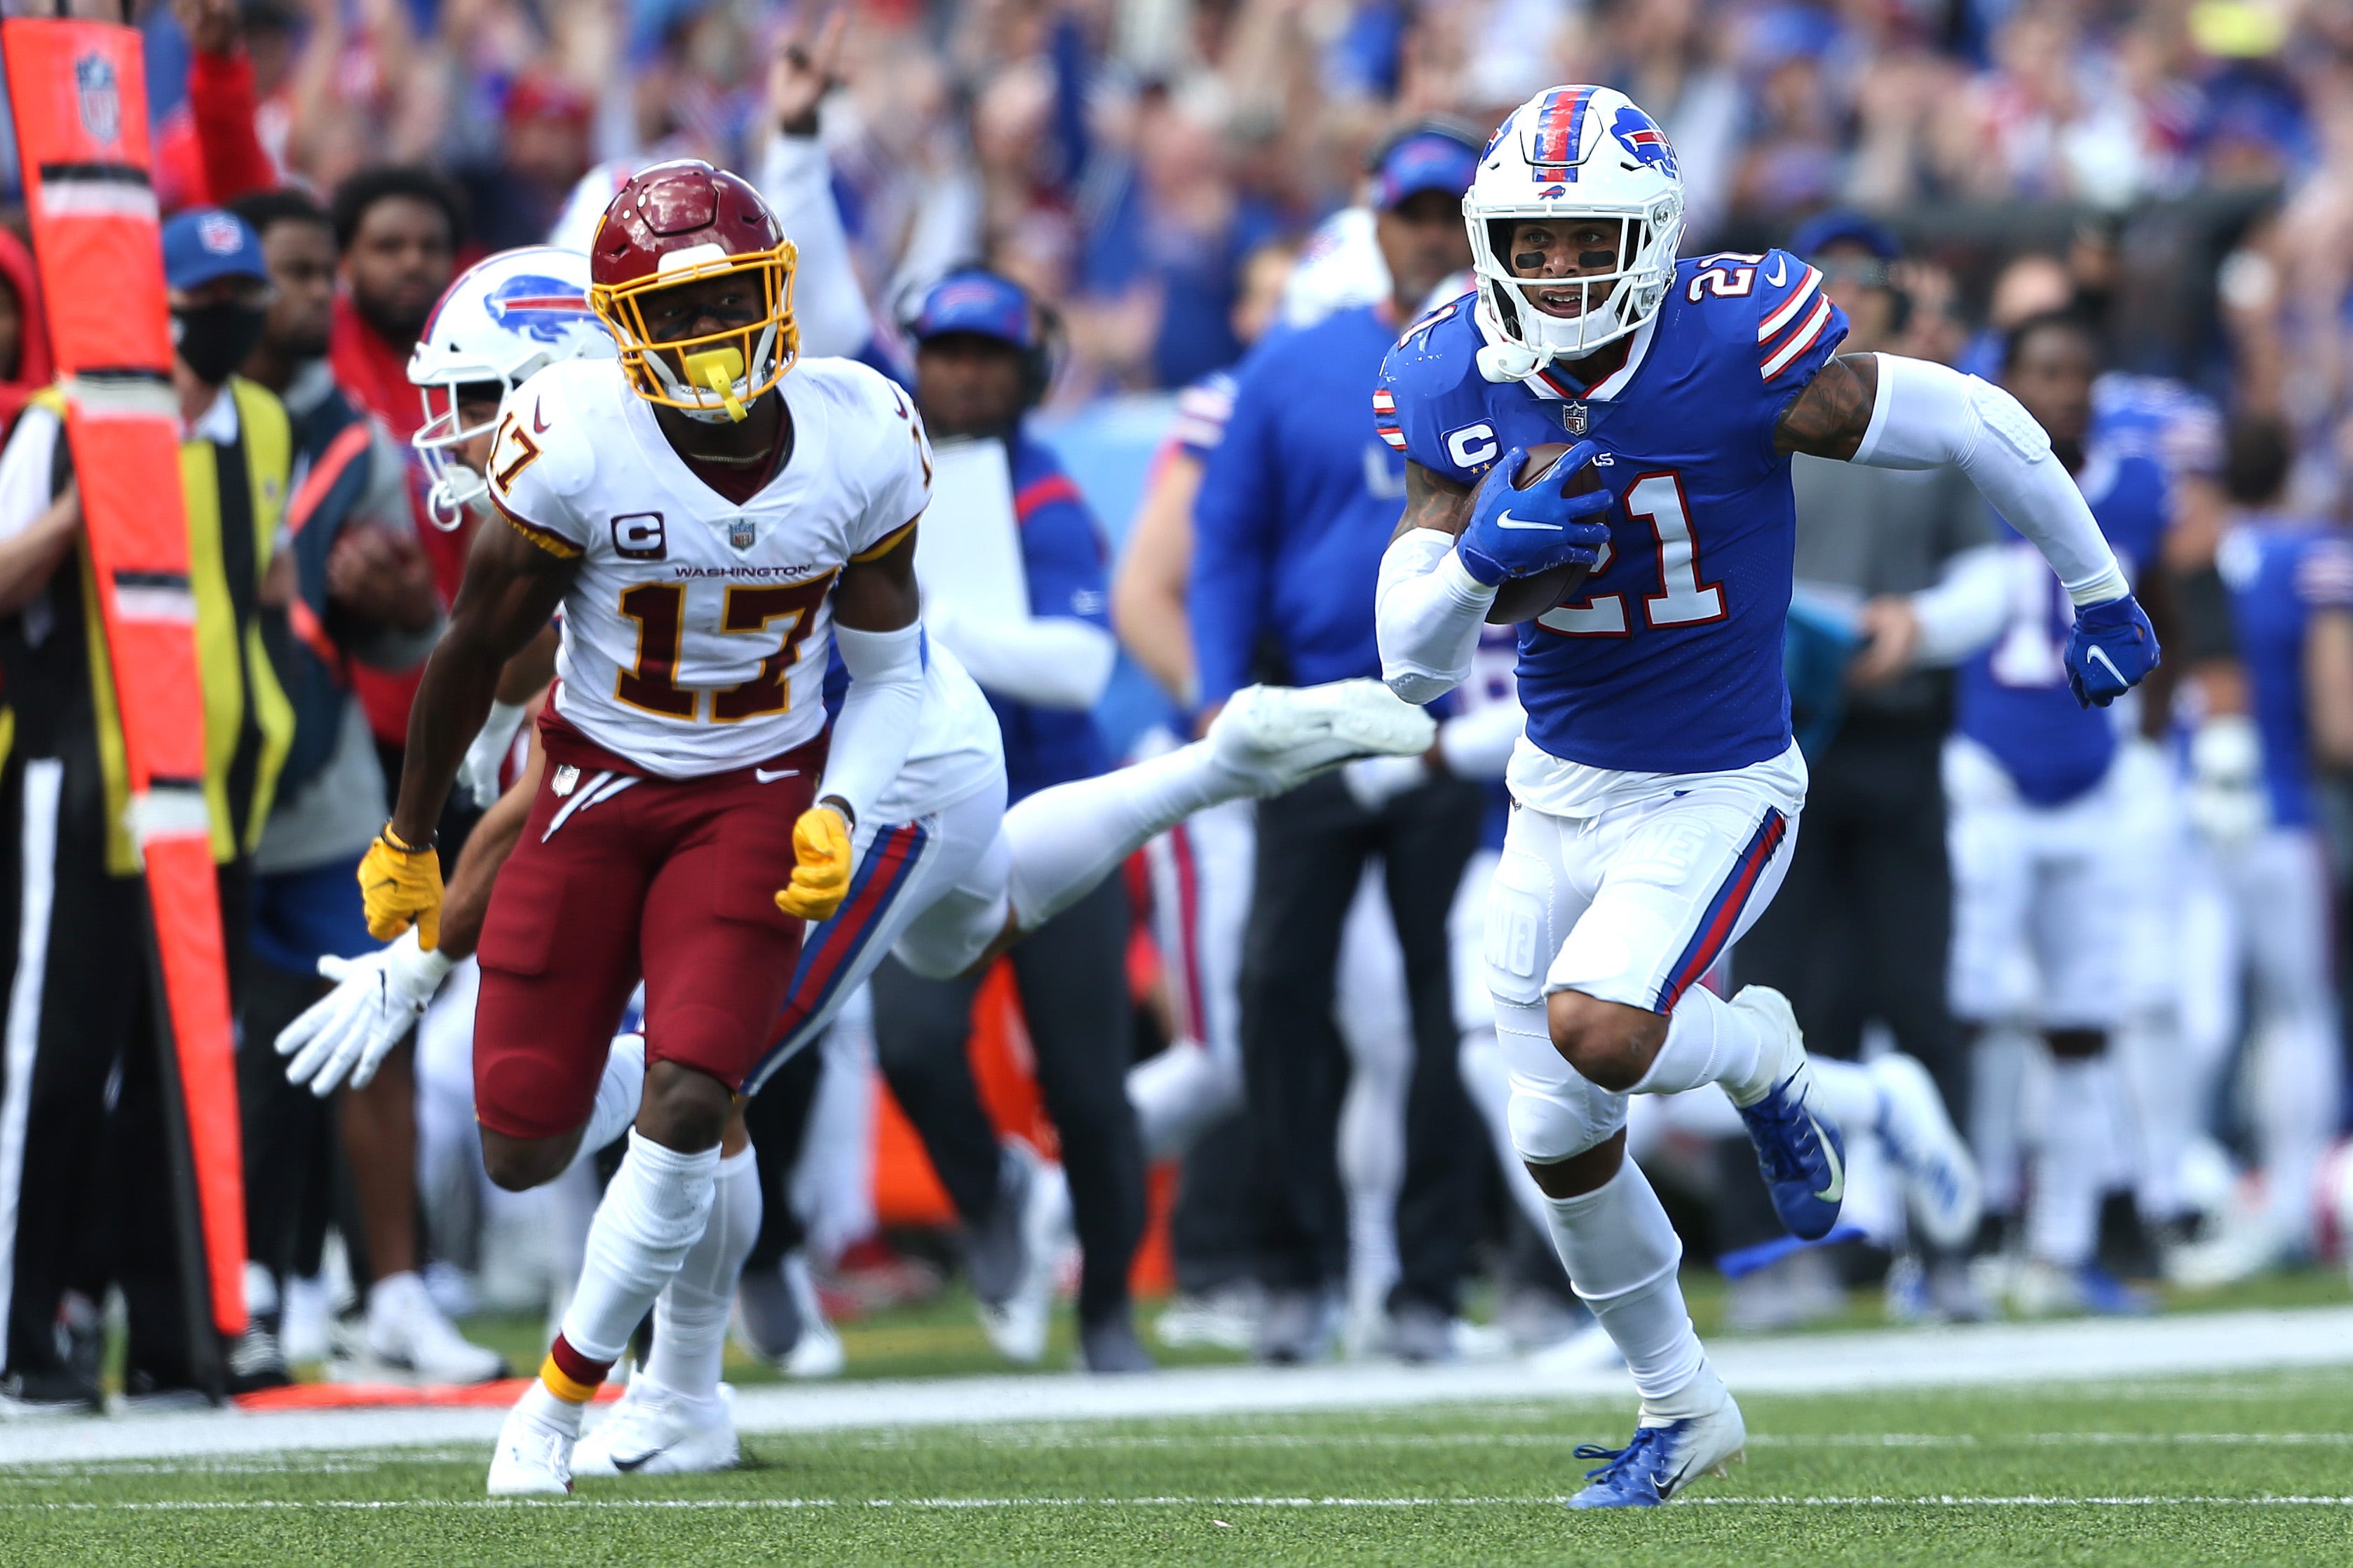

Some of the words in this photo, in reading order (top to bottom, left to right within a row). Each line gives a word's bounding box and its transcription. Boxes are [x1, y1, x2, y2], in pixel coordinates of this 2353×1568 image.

[1686, 251, 1768, 304] 21
[1566, 417, 1585, 431] NFL
[1448, 424, 1498, 468] C
[616, 514, 662, 550] C
[675, 564, 812, 578] WASHINGTON
[613, 564, 841, 724] 17
